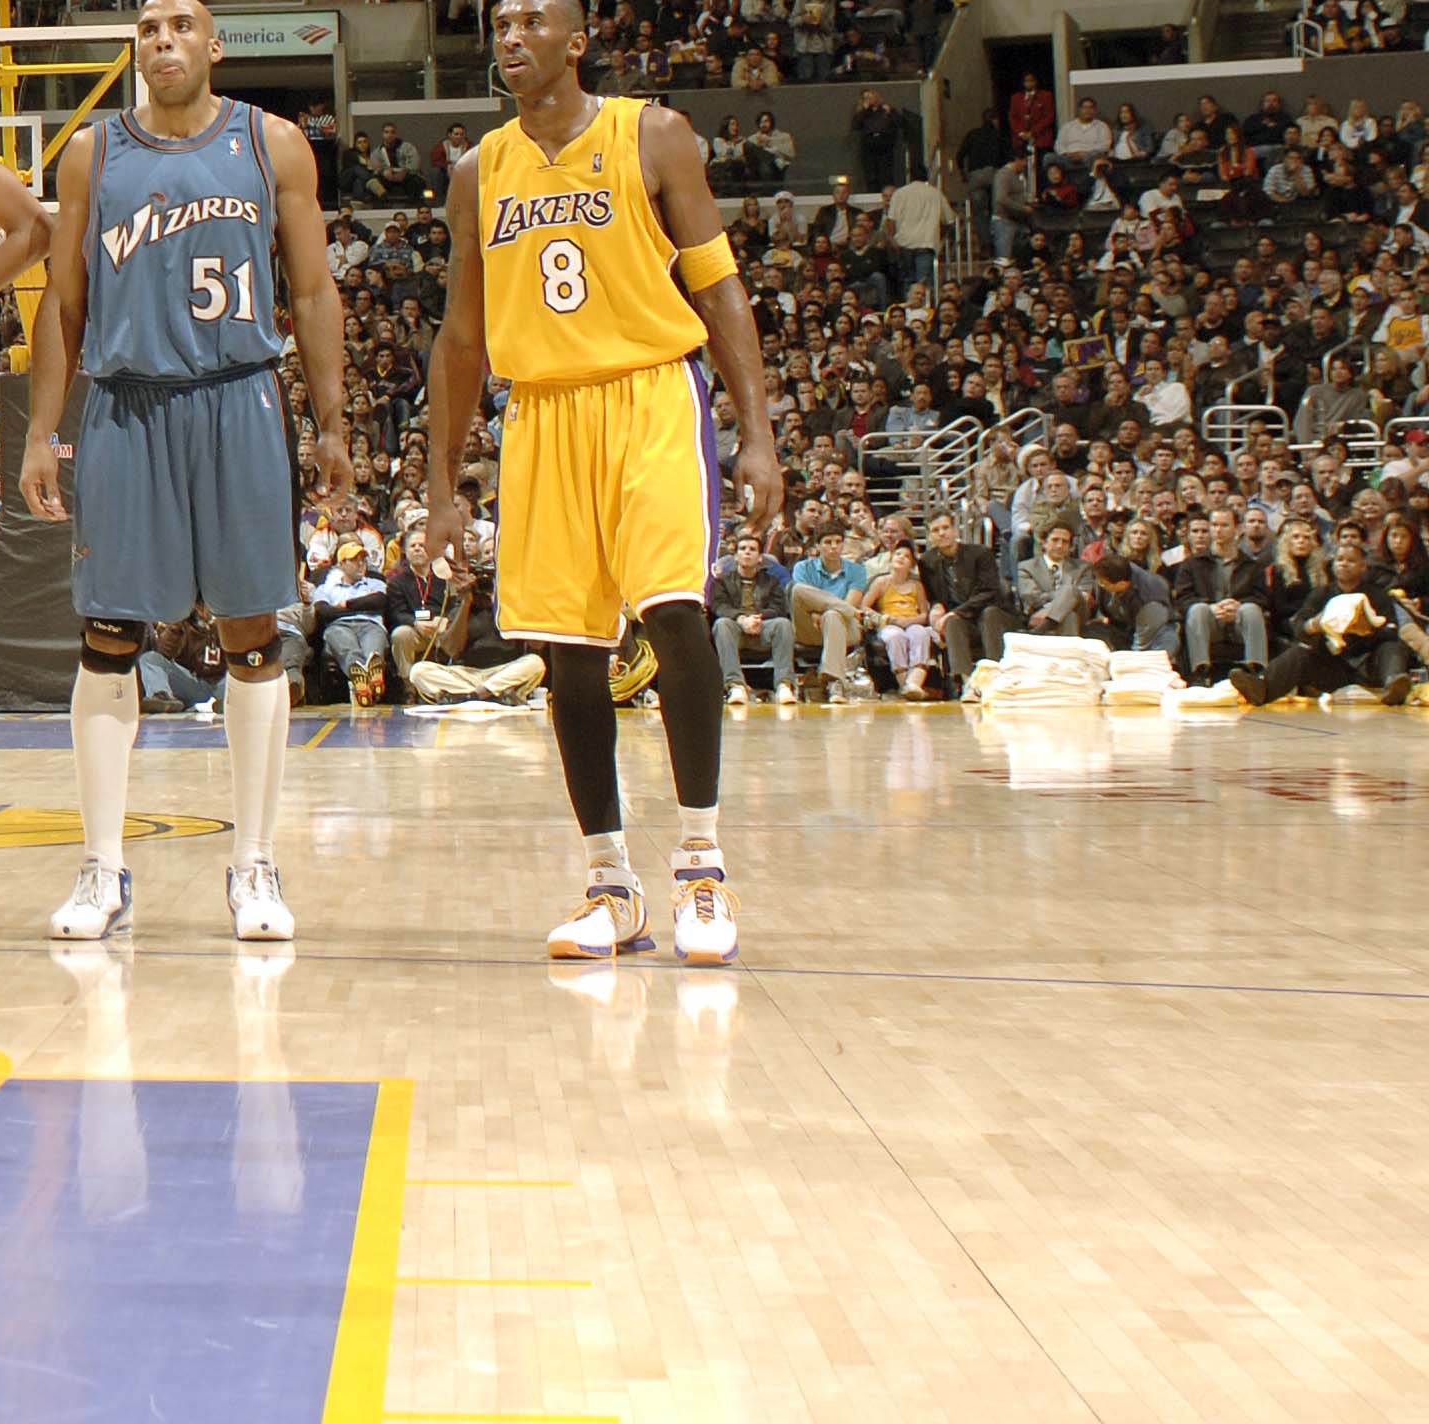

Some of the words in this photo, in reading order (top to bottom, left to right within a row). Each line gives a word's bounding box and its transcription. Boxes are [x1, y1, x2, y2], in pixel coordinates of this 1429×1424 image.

[218, 28, 285, 44] America
[101, 196, 259, 274] WIZARDS
[487, 190, 613, 251] LAKERS
[188, 255, 256, 324] 51
[540, 238, 588, 314] 8
